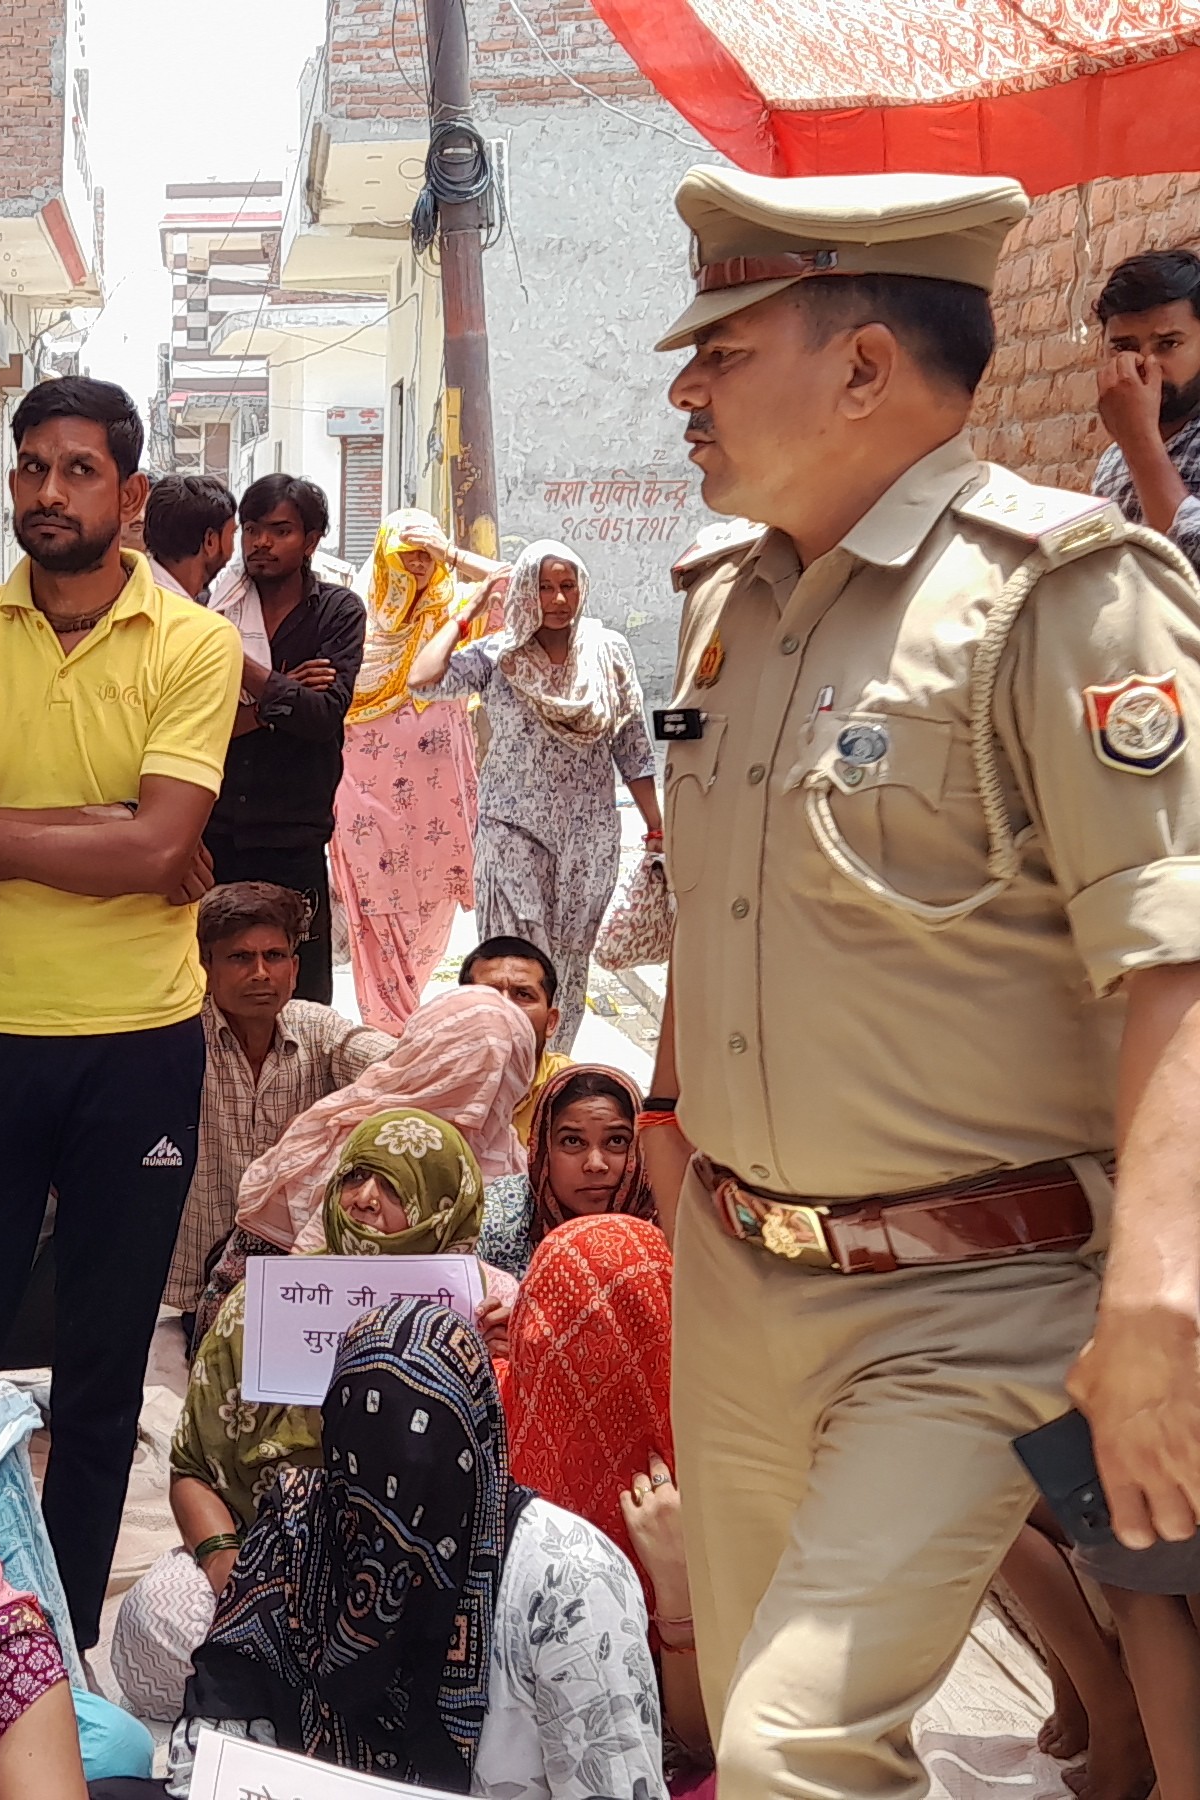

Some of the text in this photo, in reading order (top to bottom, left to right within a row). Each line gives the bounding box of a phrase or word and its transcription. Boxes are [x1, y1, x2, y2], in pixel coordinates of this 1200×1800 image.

[544, 468, 692, 514] नशा मुक्ति केन्द्र
[280, 1281, 333, 1305] योगी
[347, 1286, 376, 1307] जी
